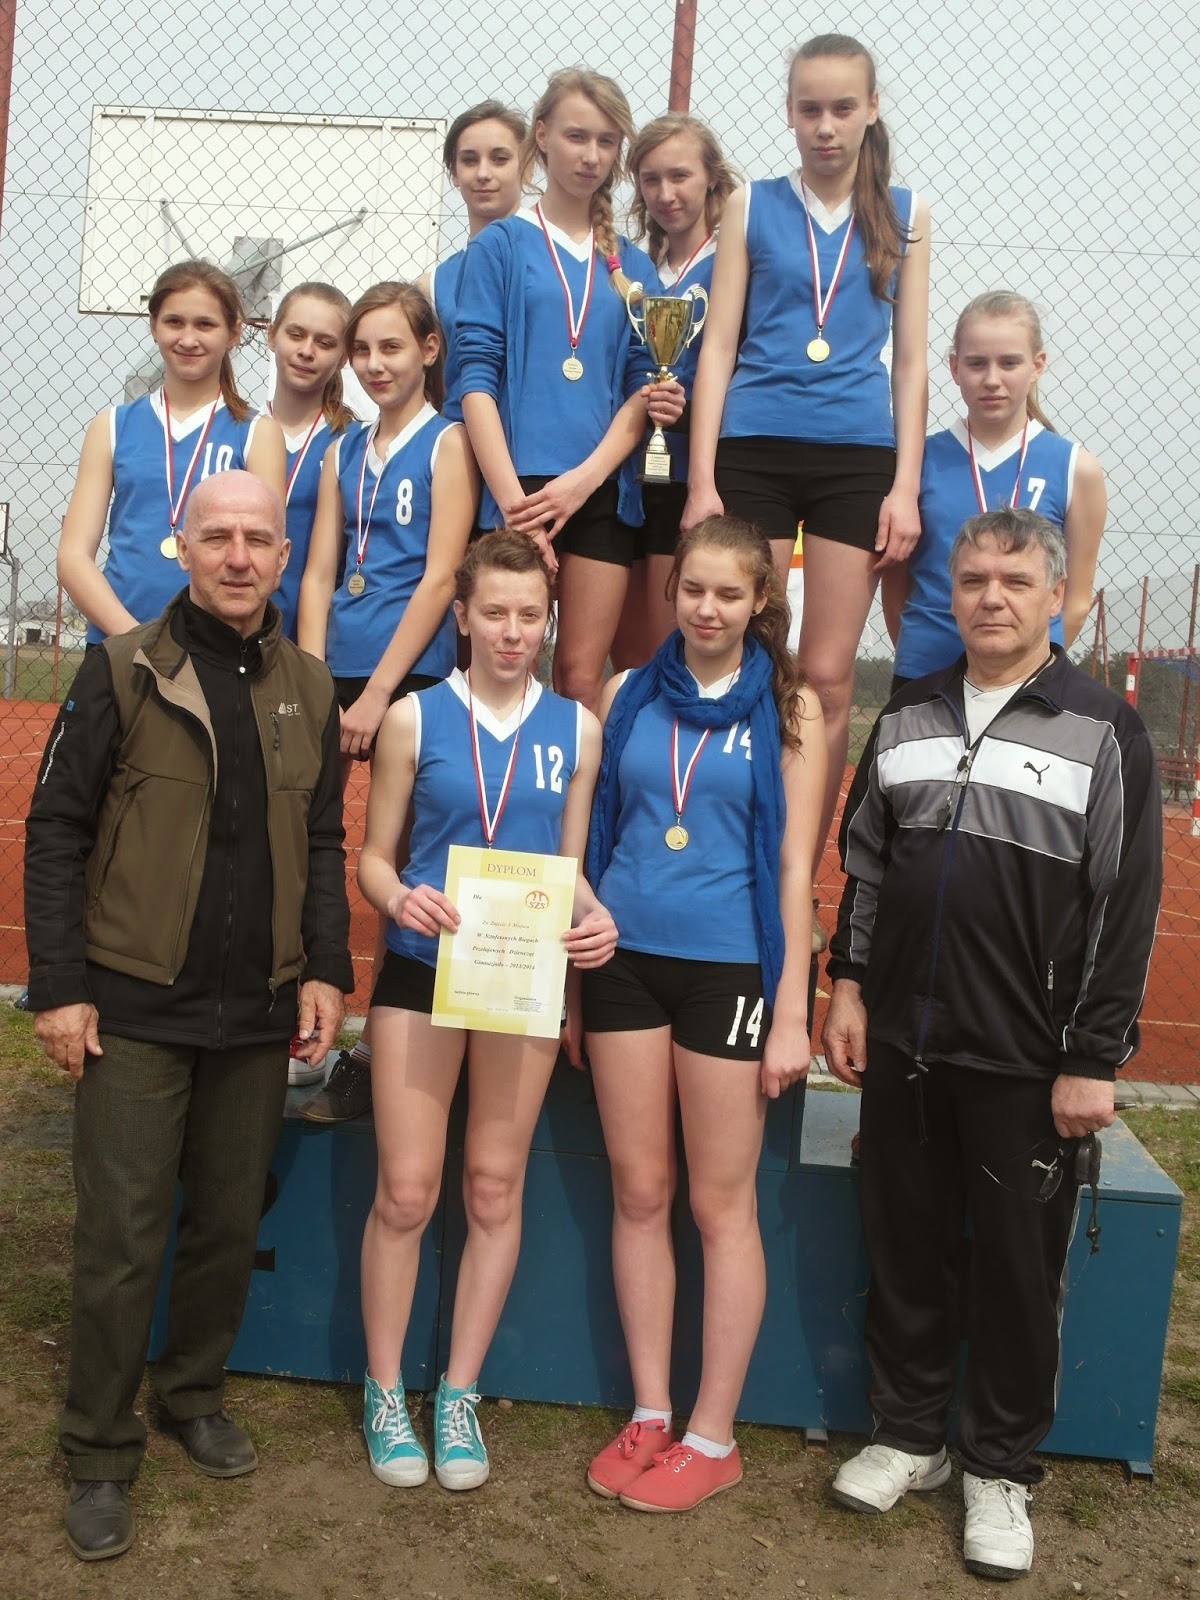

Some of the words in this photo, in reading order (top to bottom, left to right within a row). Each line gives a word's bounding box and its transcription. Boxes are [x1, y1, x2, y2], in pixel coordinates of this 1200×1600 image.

[396, 478, 413, 526] 8
[1027, 477, 1046, 511] 7
[533, 744, 563, 794] 12
[486, 863, 537, 877] DYPLOM
[528, 901, 546, 910] SZS
[726, 995, 764, 1047] 14
